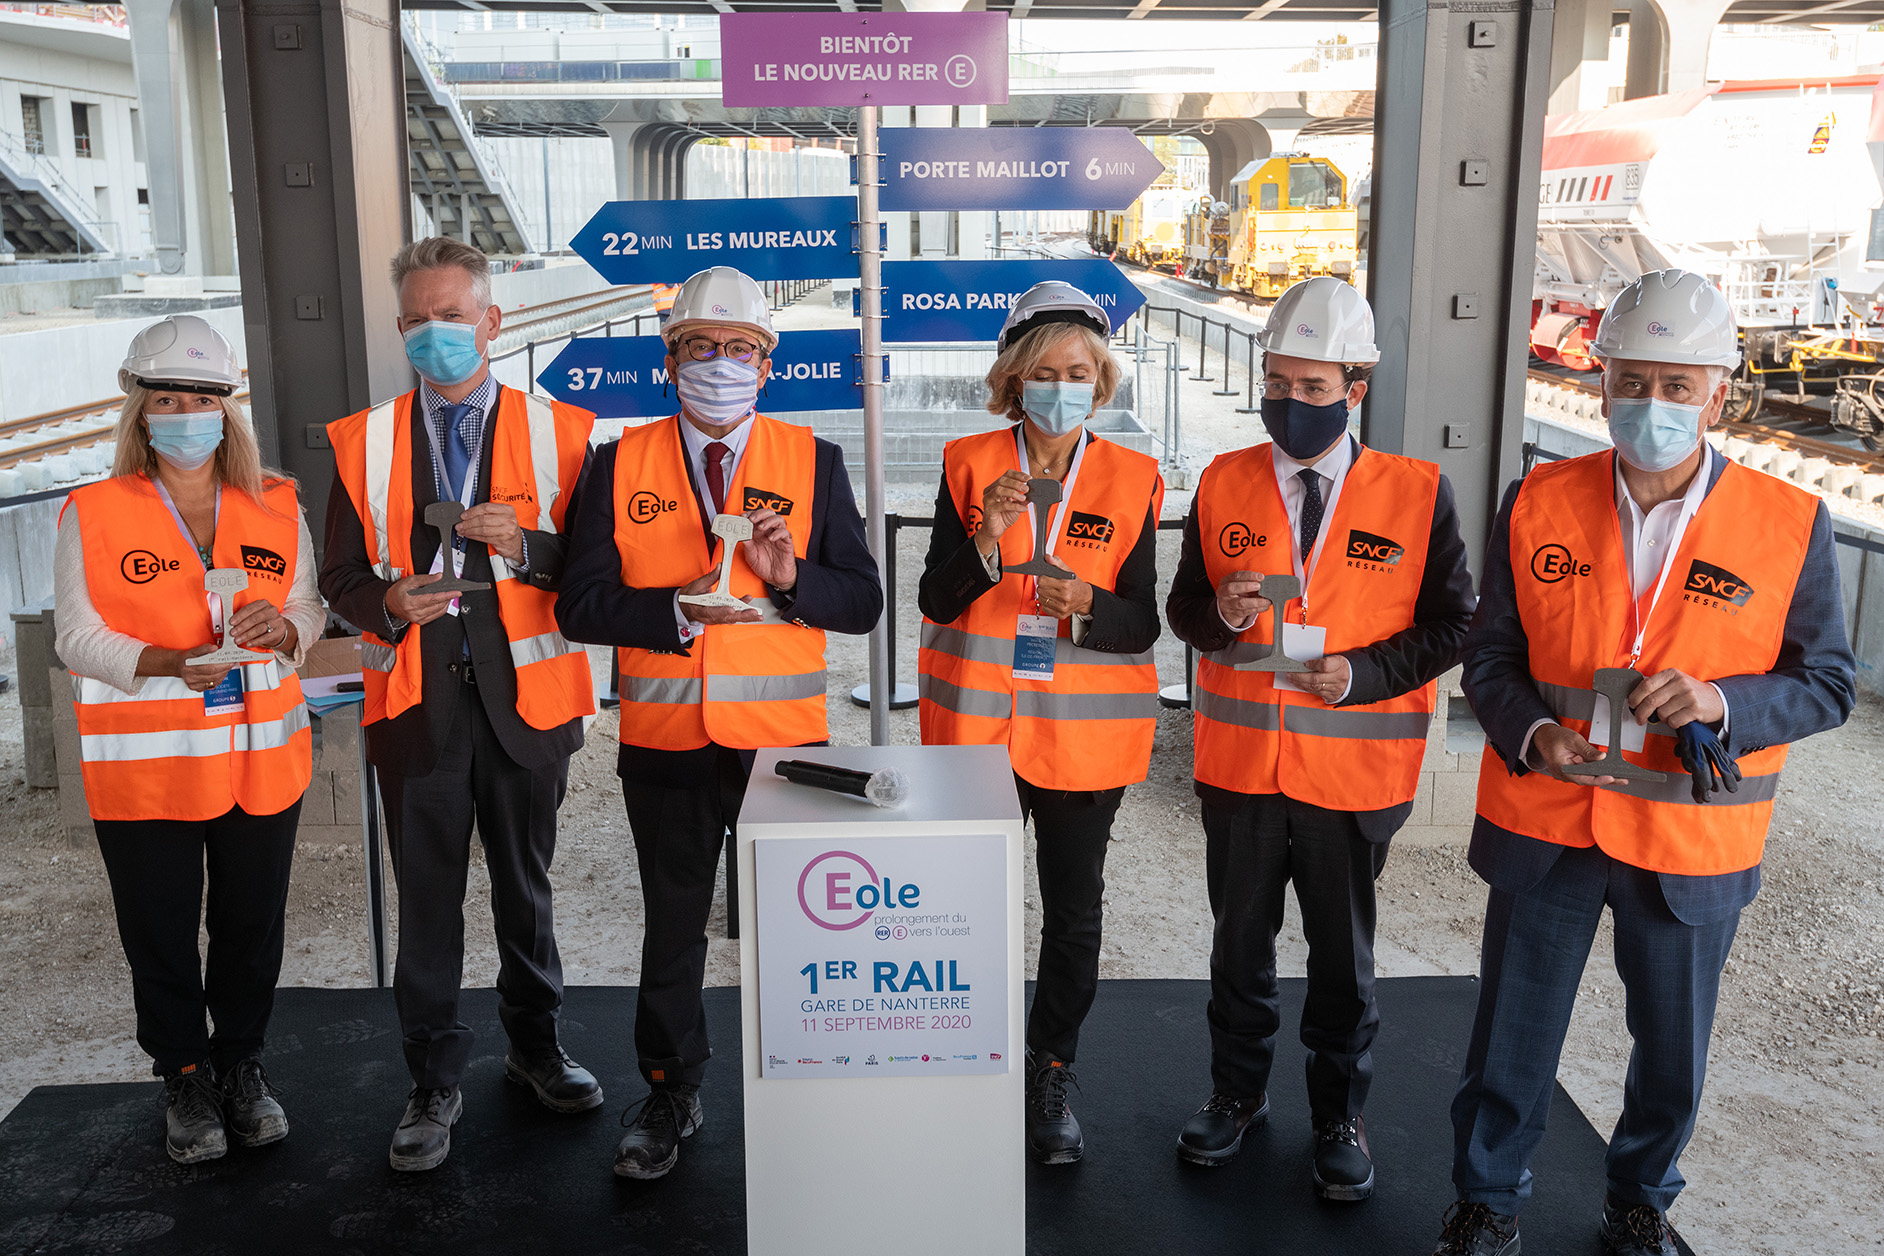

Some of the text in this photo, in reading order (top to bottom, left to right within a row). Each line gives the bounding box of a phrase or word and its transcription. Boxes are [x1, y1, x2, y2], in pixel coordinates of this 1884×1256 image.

[820, 32, 912, 54] BIENTÔT
[754, 64, 778, 81] LE
[784, 64, 892, 81] NOUVEAU
[898, 64, 938, 81] RER
[900, 158, 1135, 181] PORTE MAILLOT 6 MIN
[602, 229, 837, 256] 22 MIN LES MUREAUX
[902, 293, 961, 310] ROSA
[966, 293, 1022, 310] PARK
[567, 367, 603, 391] 37
[607, 371, 638, 384] MIN
[492, 492, 526, 502] SÉCURITÉ
[745, 497, 791, 512] SNCF
[717, 520, 750, 535] EOLE
[1069, 522, 1114, 538] SNCF
[1066, 540, 1107, 552] RÉSEAU
[1349, 541, 1401, 559] SNCF
[245, 554, 285, 571] SNCF
[1347, 560, 1394, 574] RÉSEAU
[211, 576, 243, 587] EOLE
[1688, 573, 1750, 599] SNCF
[1683, 594, 1738, 616] RÉSEAU
[874, 913, 967, 926] prolongement du
[909, 927, 933, 937] vers
[935, 925, 971, 937] l'ouest
[800, 959, 971, 995] 1ER RAIL
[800, 996, 971, 1013] GARE DE NANTERRE
[801, 1014, 972, 1032] 11 SEPTEMBRE 2020
